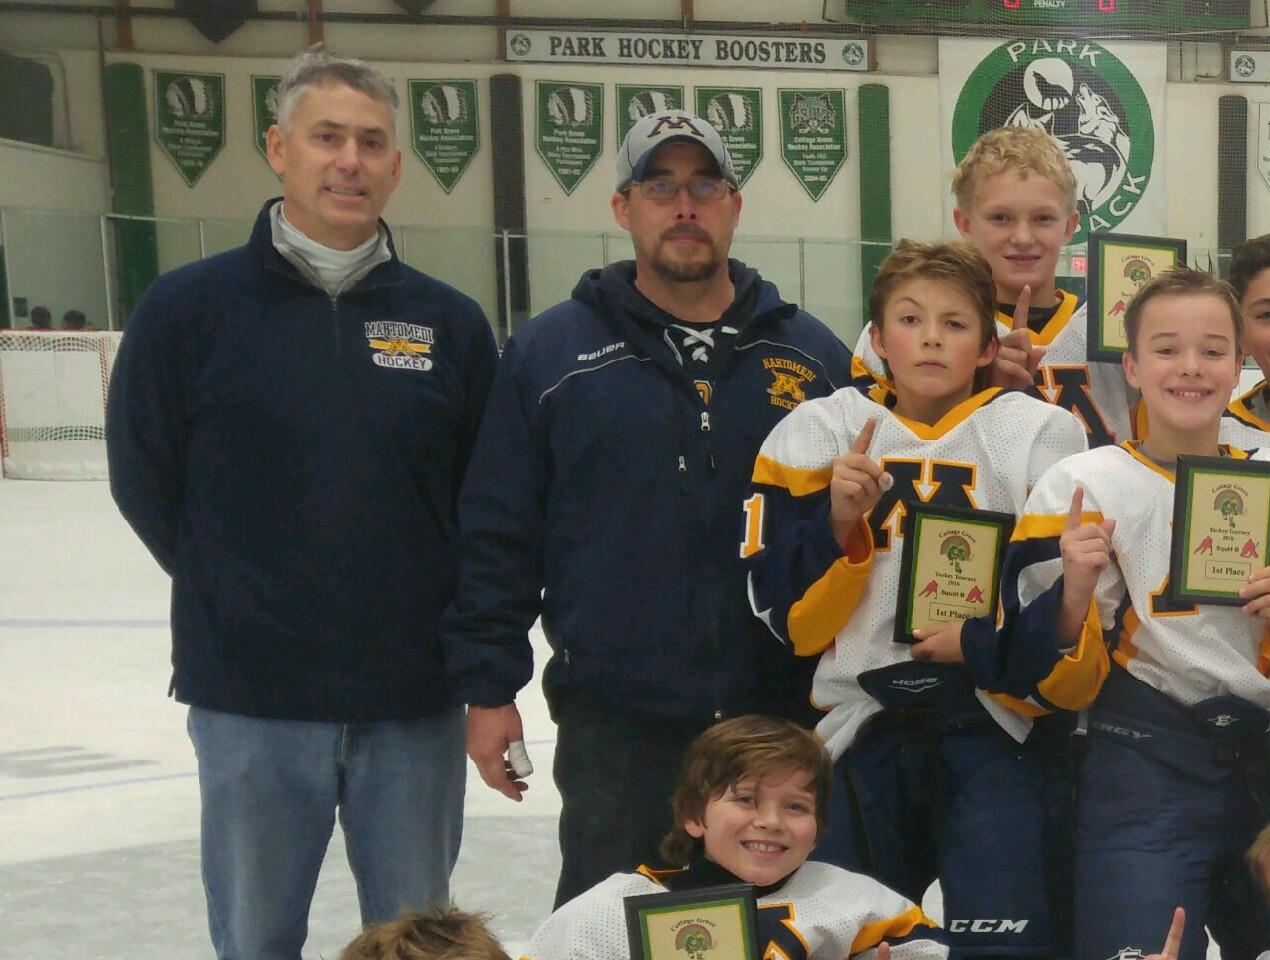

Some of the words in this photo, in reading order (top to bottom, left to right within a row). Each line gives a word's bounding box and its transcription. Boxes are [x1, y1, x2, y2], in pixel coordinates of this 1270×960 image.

[549, 35, 606, 58] PARK
[618, 37, 703, 61] HOCKEY
[715, 39, 827, 64] BOOSTERS
[1007, 38, 1103, 68] PARK
[647, 116, 705, 138] M
[1076, 173, 1146, 233] ACK
[364, 320, 435, 344] MAHTOMEDI
[577, 341, 625, 361] BAUER
[378, 355, 426, 369] HOCKEY
[762, 357, 817, 383] MAHTOMEDI
[739, 492, 765, 559] 1
[1212, 566, 1222, 574] 1st
[1225, 567, 1245, 576] Place
[941, 589, 958, 598] Squirt
[949, 609, 970, 619] Place
[670, 918, 695, 932] Cottage
[697, 918, 716, 928] Grove
[949, 919, 1029, 933] CCM
